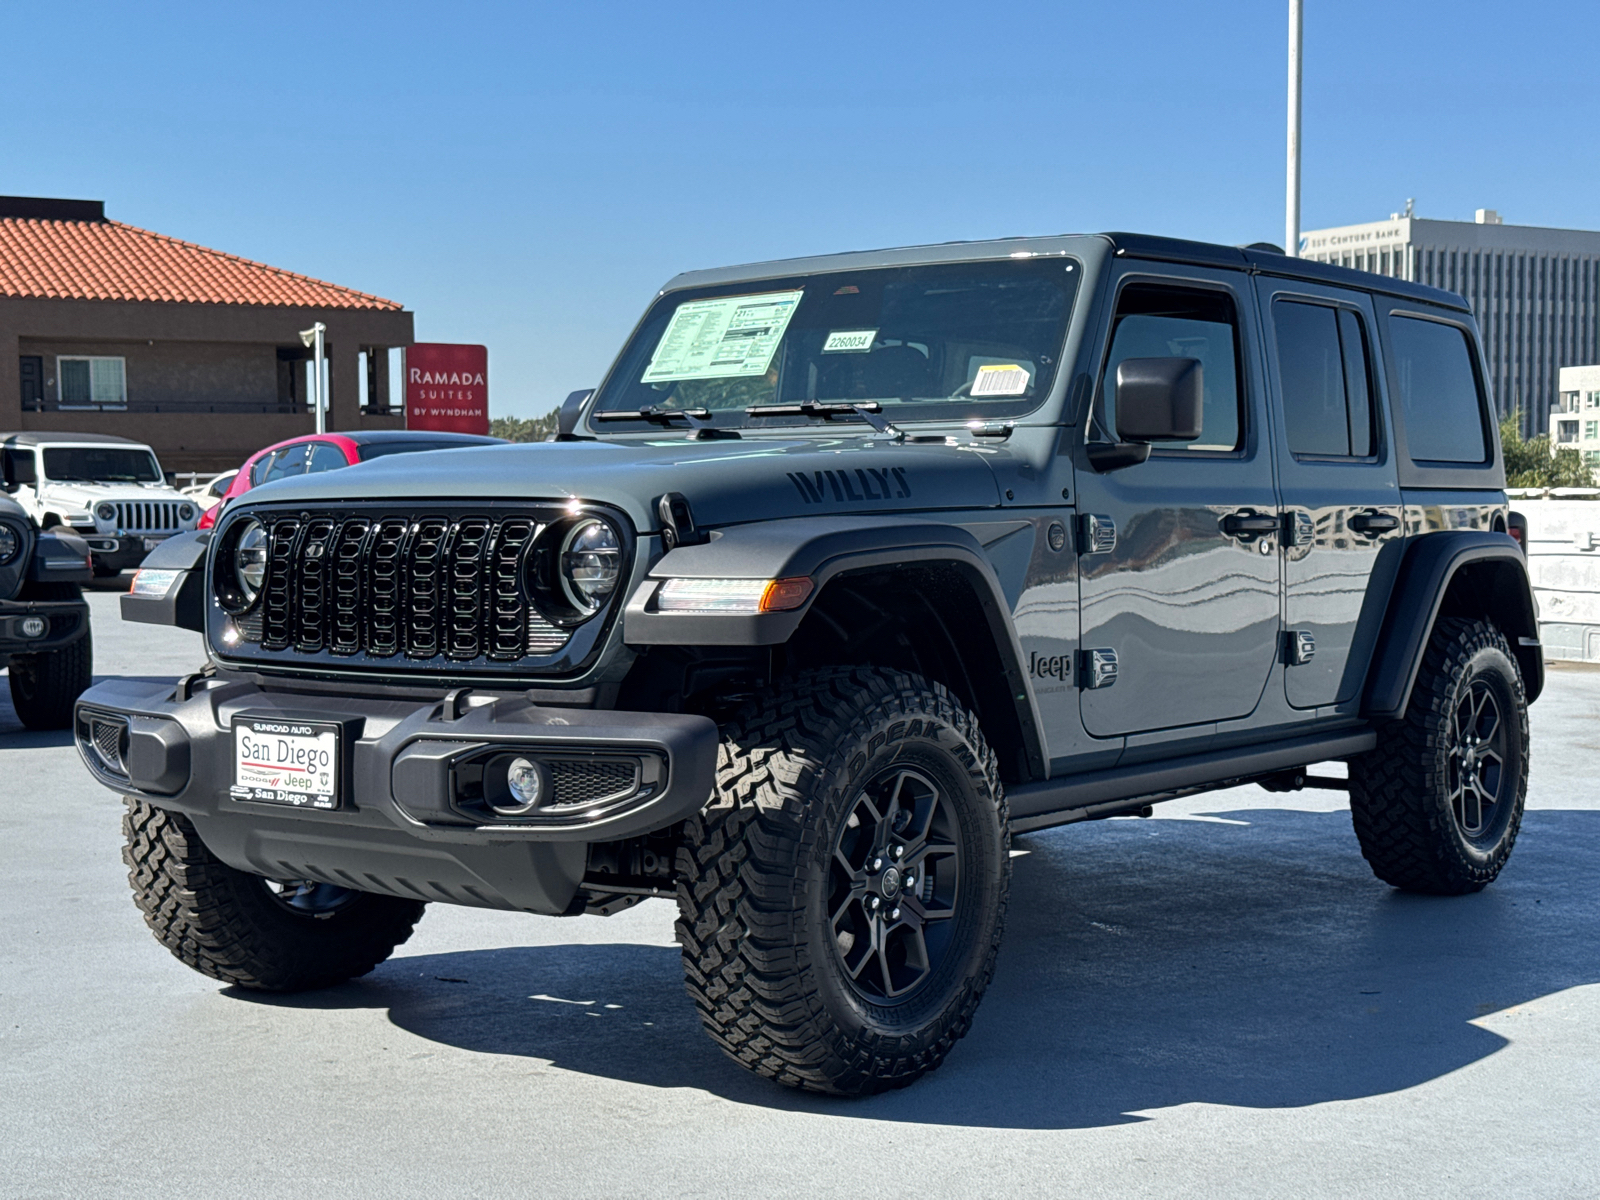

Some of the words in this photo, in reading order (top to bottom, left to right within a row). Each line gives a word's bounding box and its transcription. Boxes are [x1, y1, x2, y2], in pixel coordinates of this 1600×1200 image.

[1330, 232, 1371, 245] CENTURY
[1375, 229, 1400, 239] BANK
[829, 336, 867, 348] 2260034
[410, 368, 484, 386] RAMADA
[420, 390, 473, 400] SUITES
[414, 407, 426, 416] BY
[431, 408, 482, 417] WYNDHAM
[786, 467, 911, 504] WILLYS
[1027, 651, 1072, 681] Jeep
[253, 723, 290, 733] SUNROAD
[291, 726, 313, 735] AUTO
[242, 736, 270, 761] San
[277, 739, 329, 774] Diego
[284, 773, 313, 790] Jeep
[255, 788, 274, 798] San
[277, 790, 307, 805] Diego
